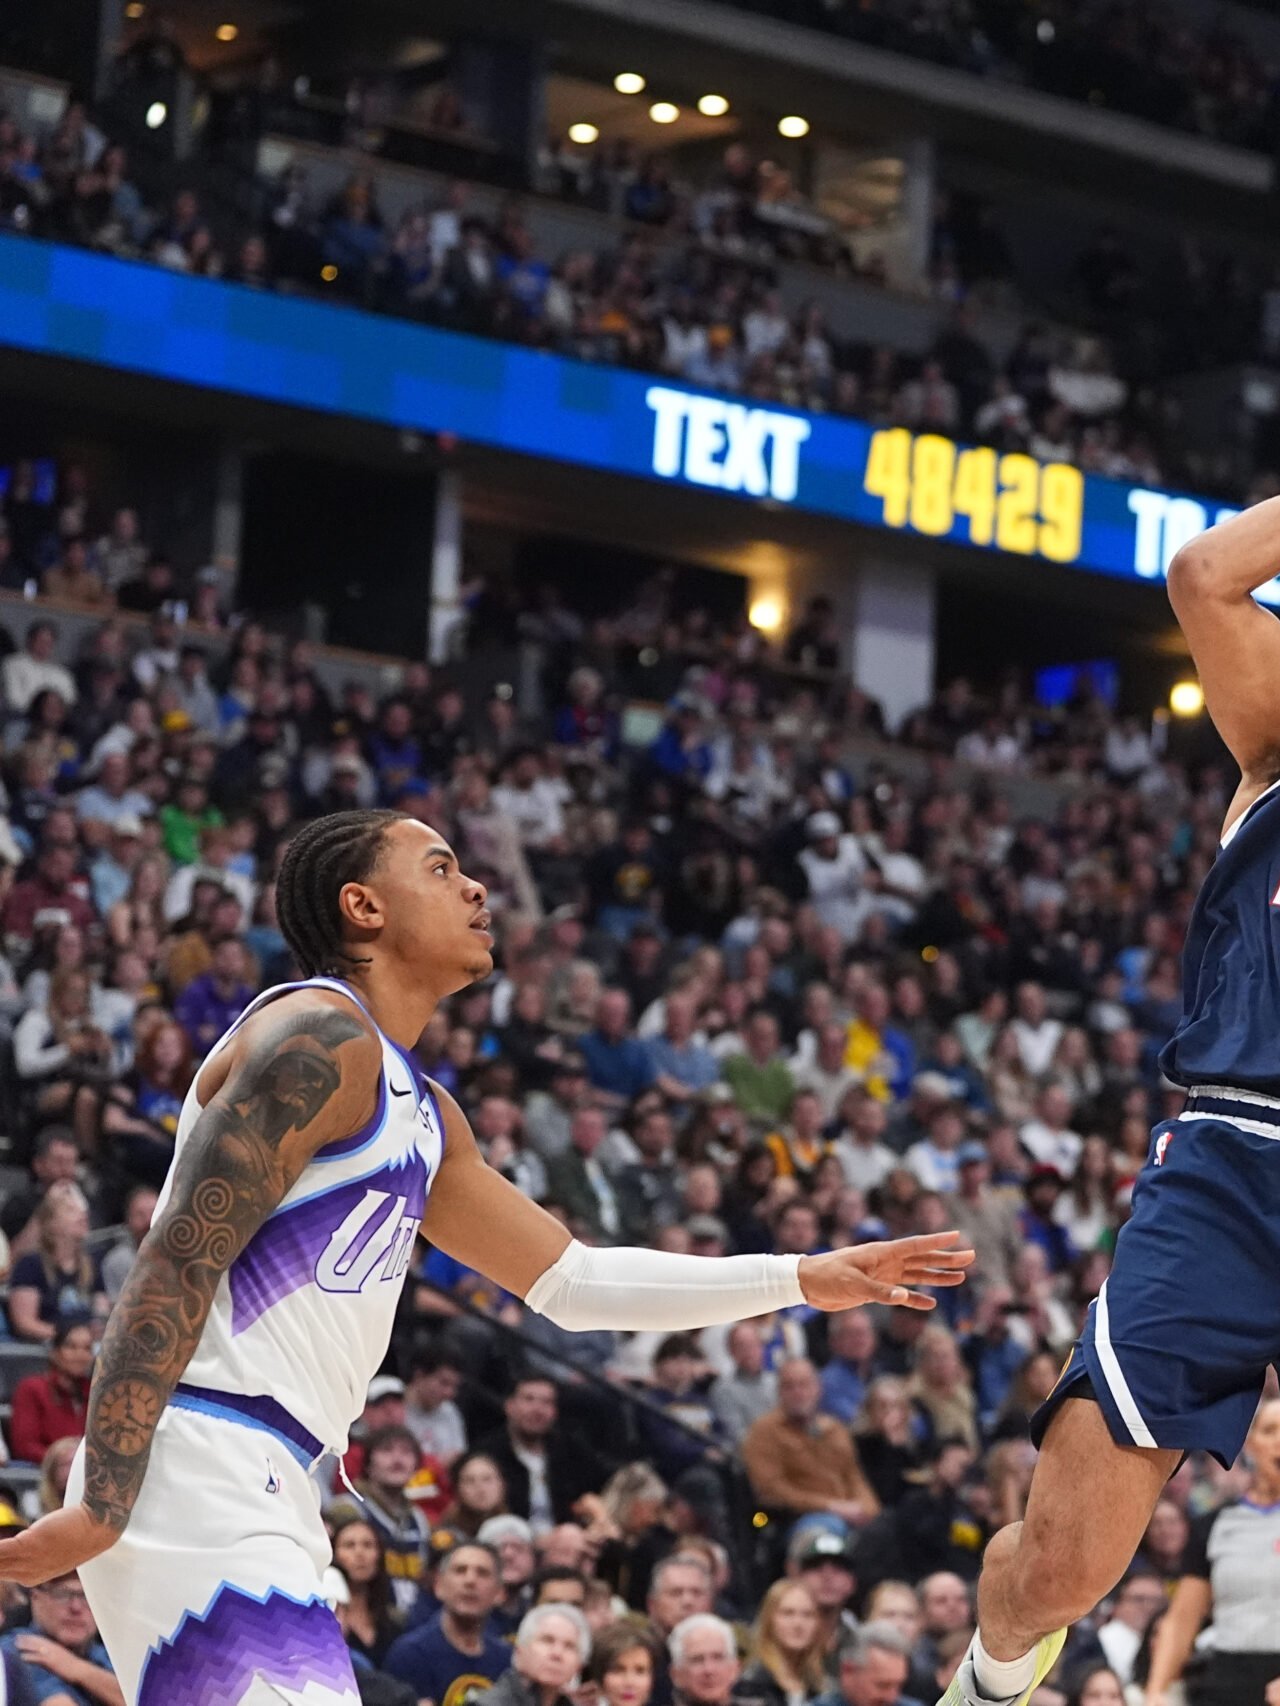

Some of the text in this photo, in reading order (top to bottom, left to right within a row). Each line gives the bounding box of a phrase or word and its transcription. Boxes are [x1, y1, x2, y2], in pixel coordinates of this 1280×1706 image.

[646, 386, 811, 501] TEXT
[865, 428, 1085, 564] 48429
[1128, 490, 1207, 579] TO
